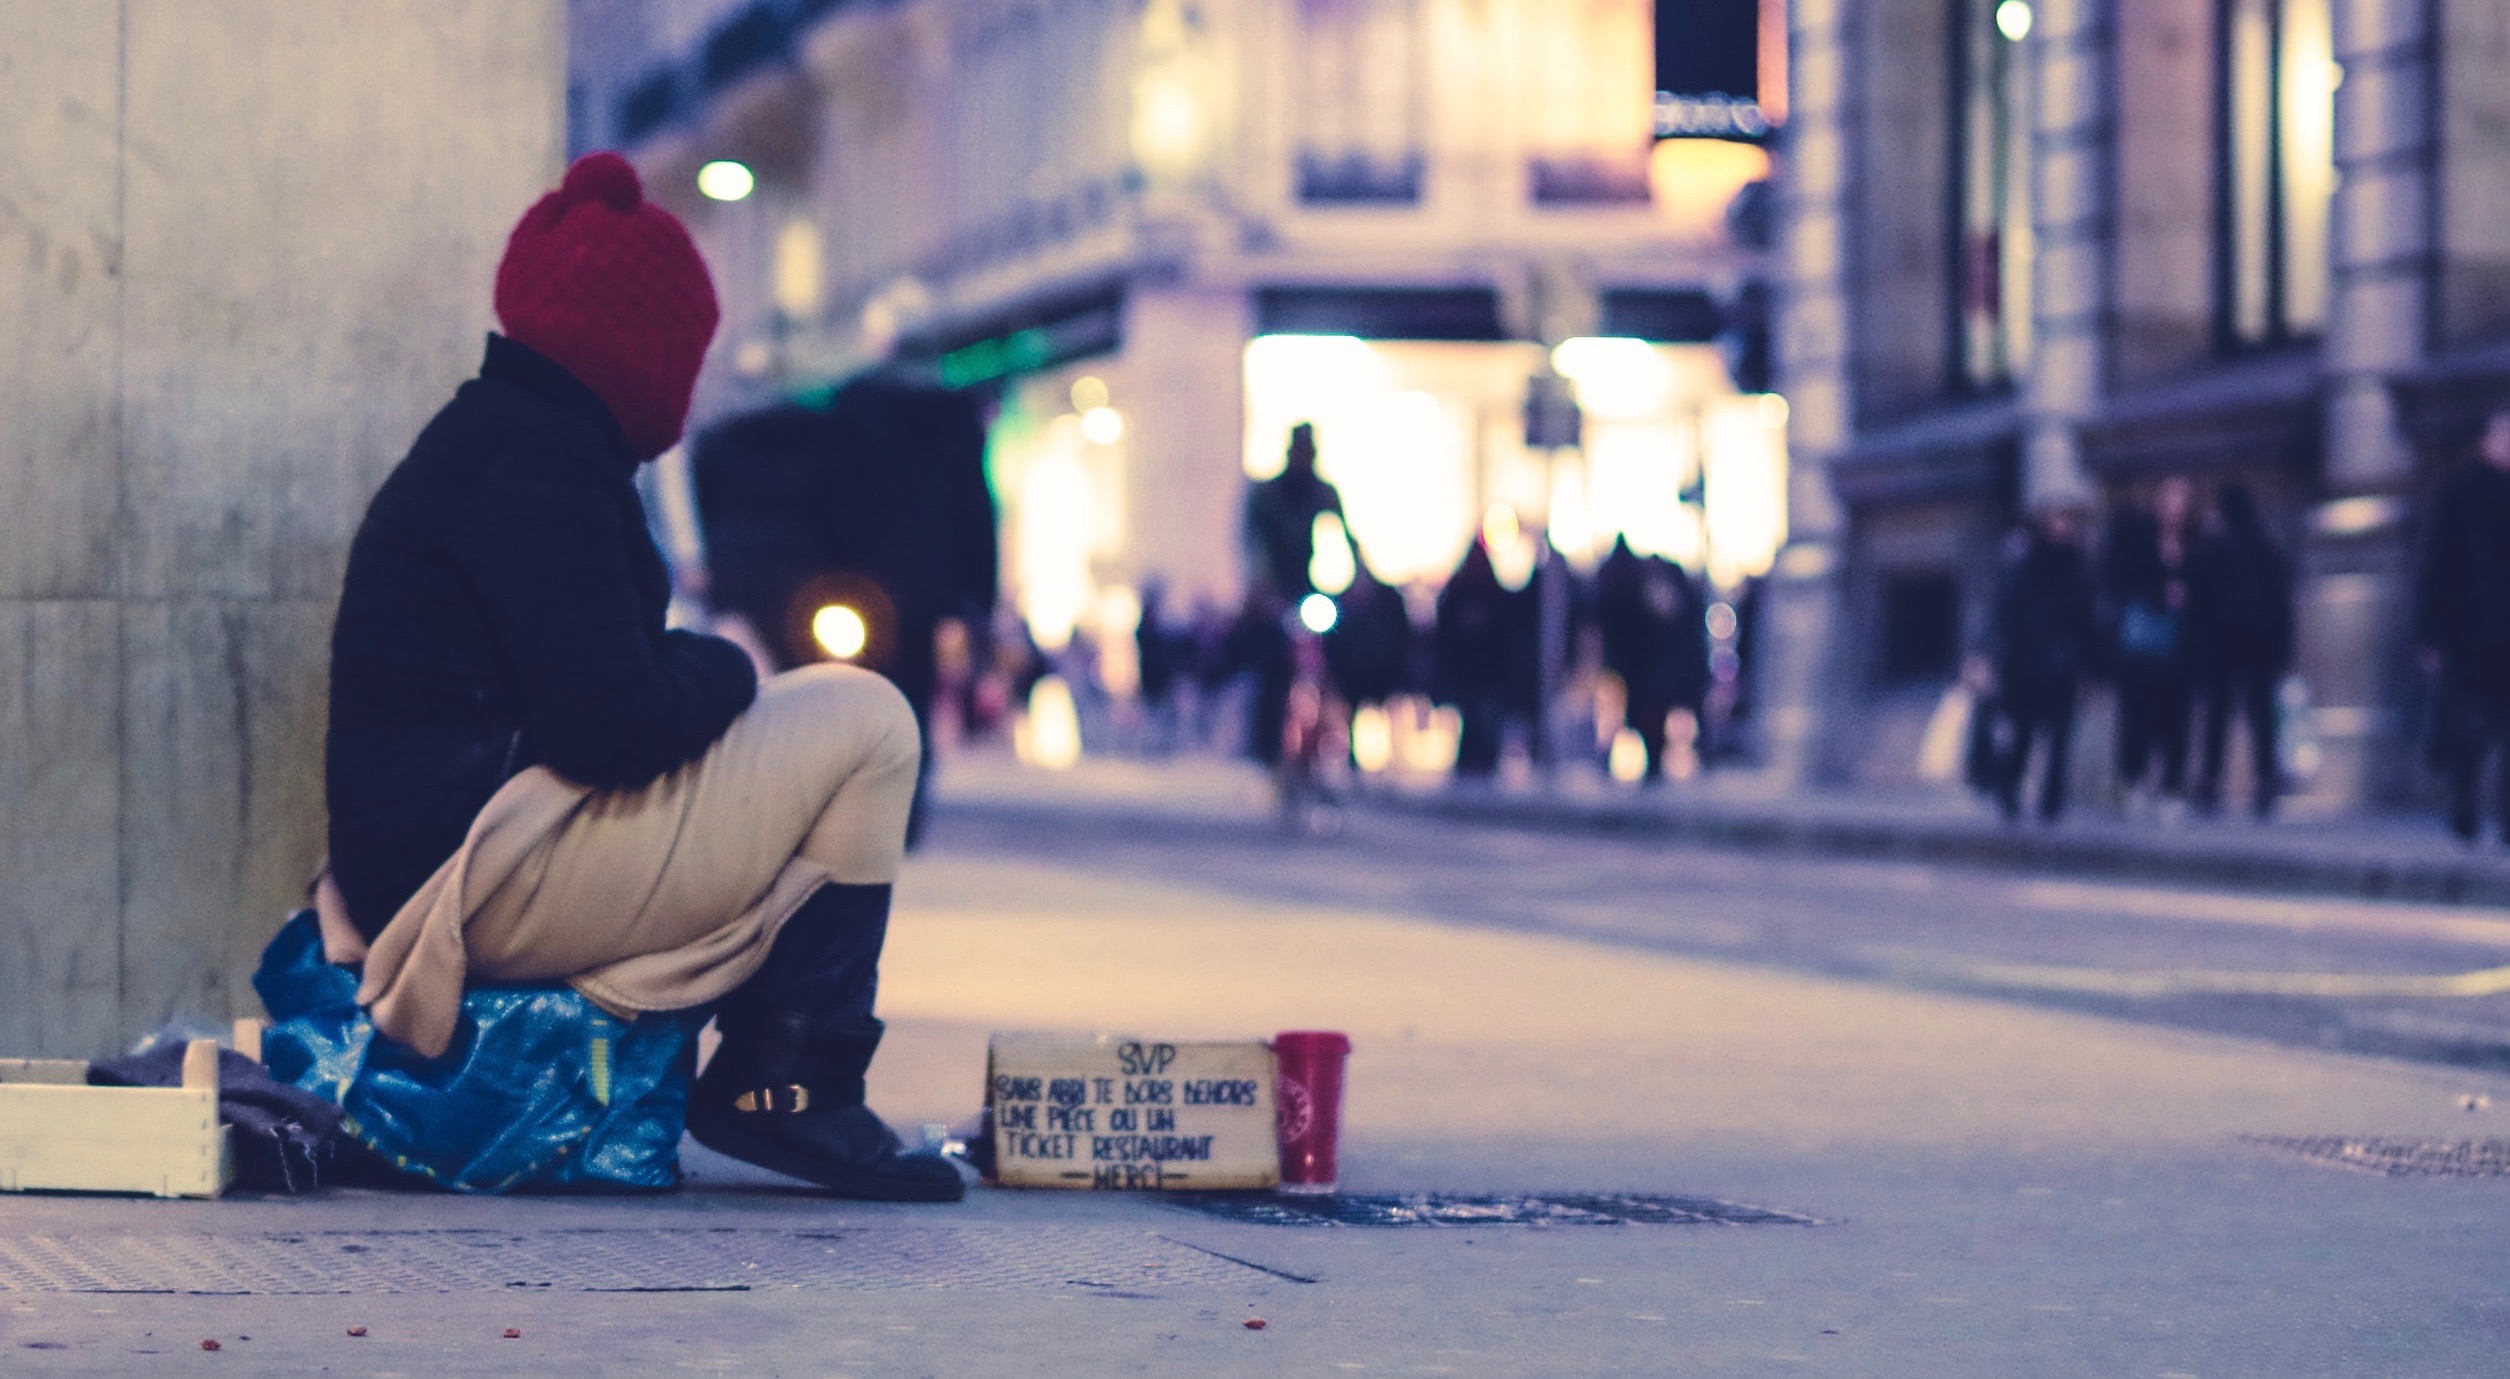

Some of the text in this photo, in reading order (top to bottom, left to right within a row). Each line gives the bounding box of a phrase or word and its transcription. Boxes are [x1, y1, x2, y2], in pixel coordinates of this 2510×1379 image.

[1118, 1042, 1176, 1075] SVP
[996, 1075, 1042, 1101] SANS
[1184, 1078, 1257, 1106] DEHORS
[1001, 1105, 1036, 1130] UNE
[1110, 1109, 1136, 1131] OU
[1147, 1108, 1174, 1132] UN
[1006, 1131, 1214, 1161] TICKET RESTAURANT
